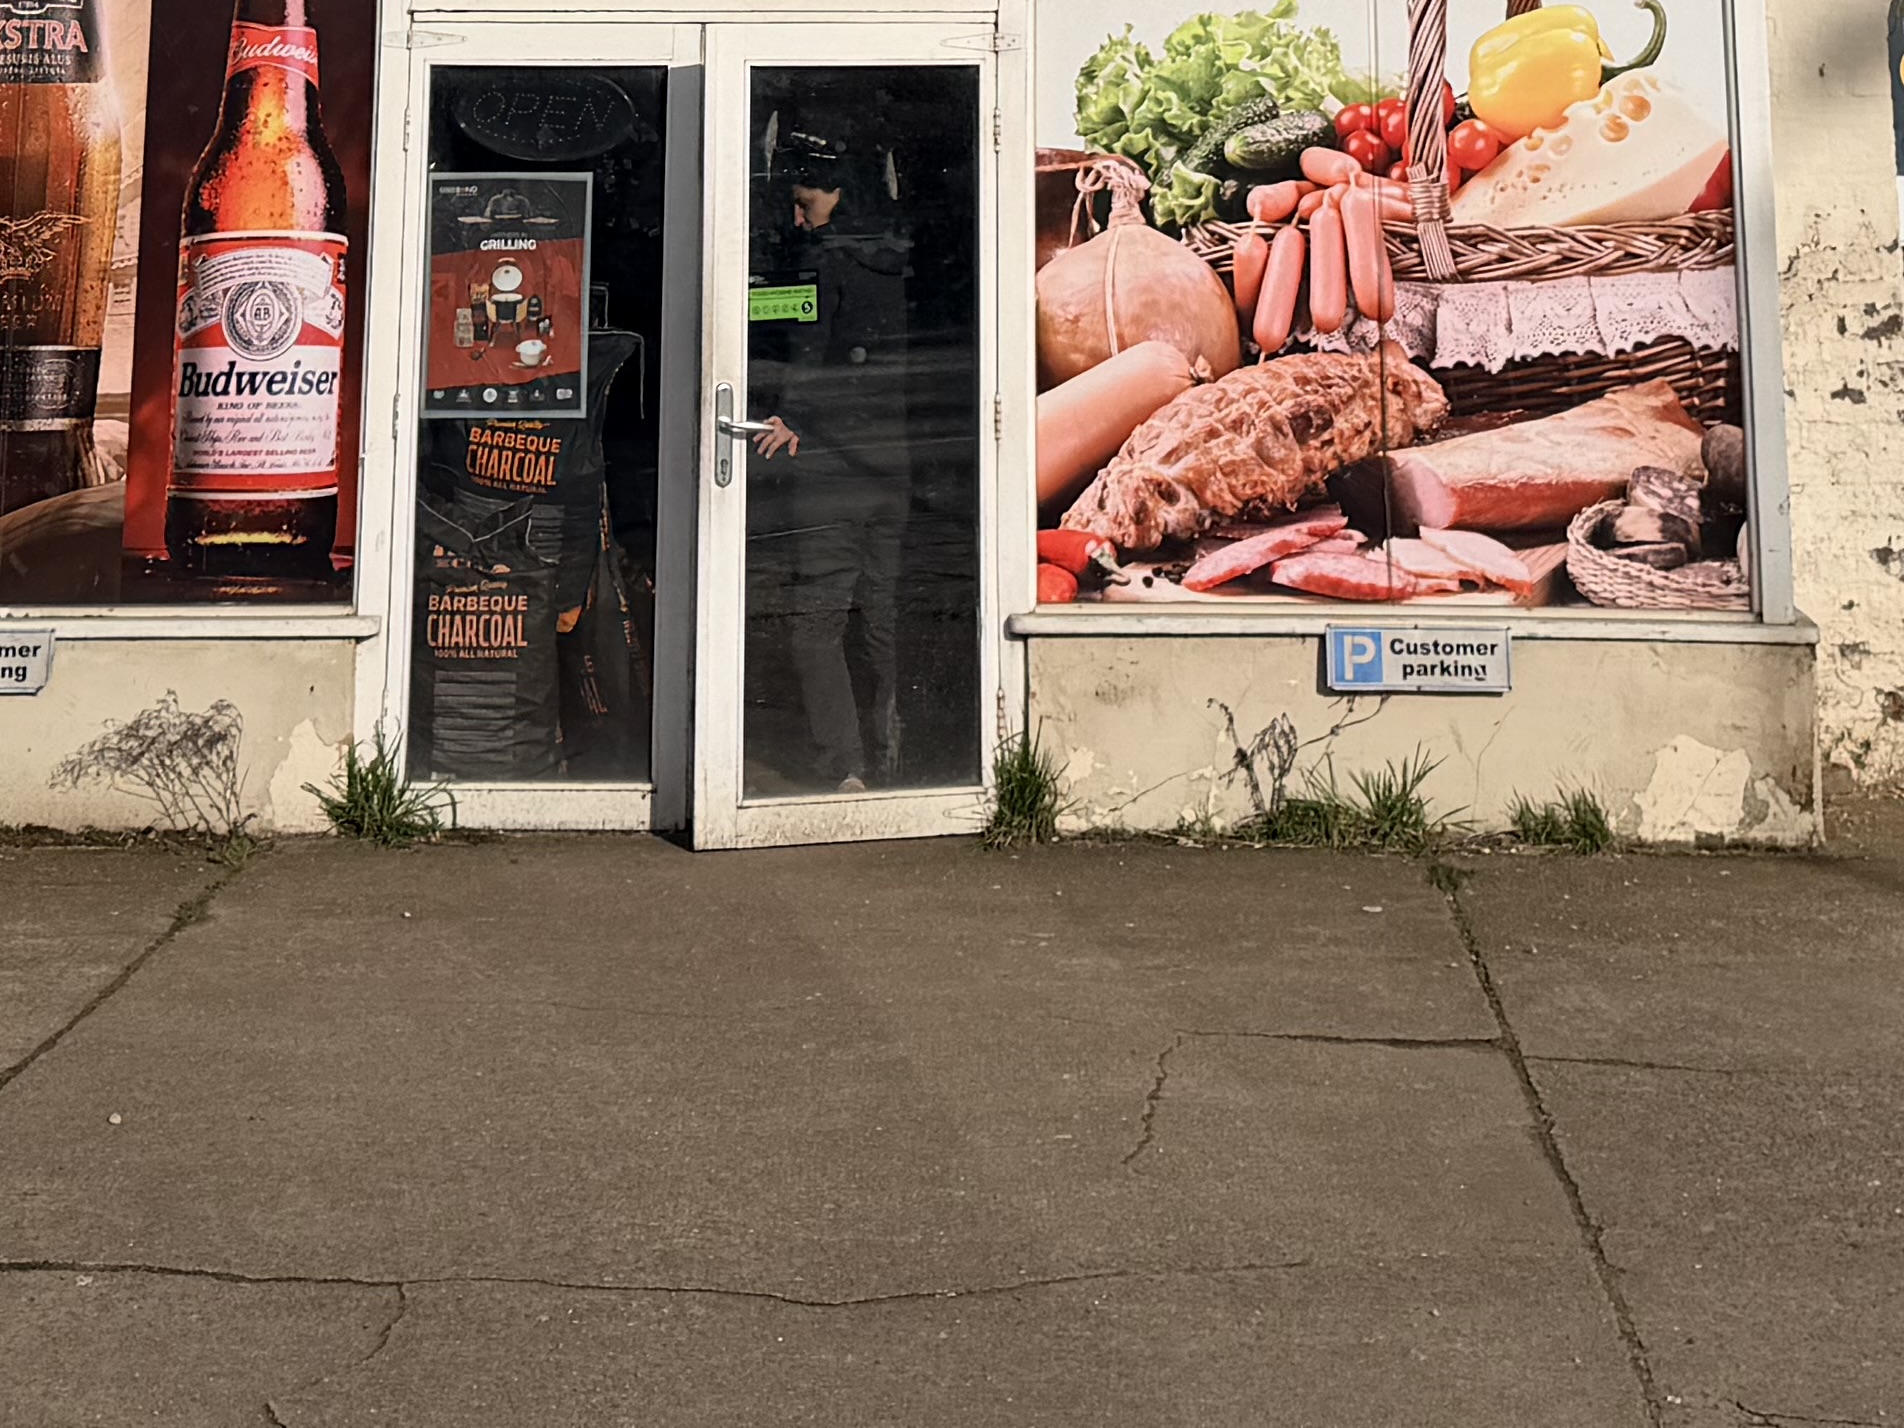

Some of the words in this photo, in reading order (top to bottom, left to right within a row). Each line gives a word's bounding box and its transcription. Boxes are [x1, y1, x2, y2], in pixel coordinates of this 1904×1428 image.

[472, 90, 615, 132] OPEN
[479, 238, 538, 252] GRILLING
[178, 359, 338, 398] Budweiser
[468, 426, 562, 454] BARBEQUE
[465, 444, 557, 487] CHARCOAL
[427, 595, 529, 613] BARBEQUE
[426, 614, 529, 648] CHARCOAL
[1389, 638, 1499, 656] Customer
[1402, 660, 1487, 682] parking
